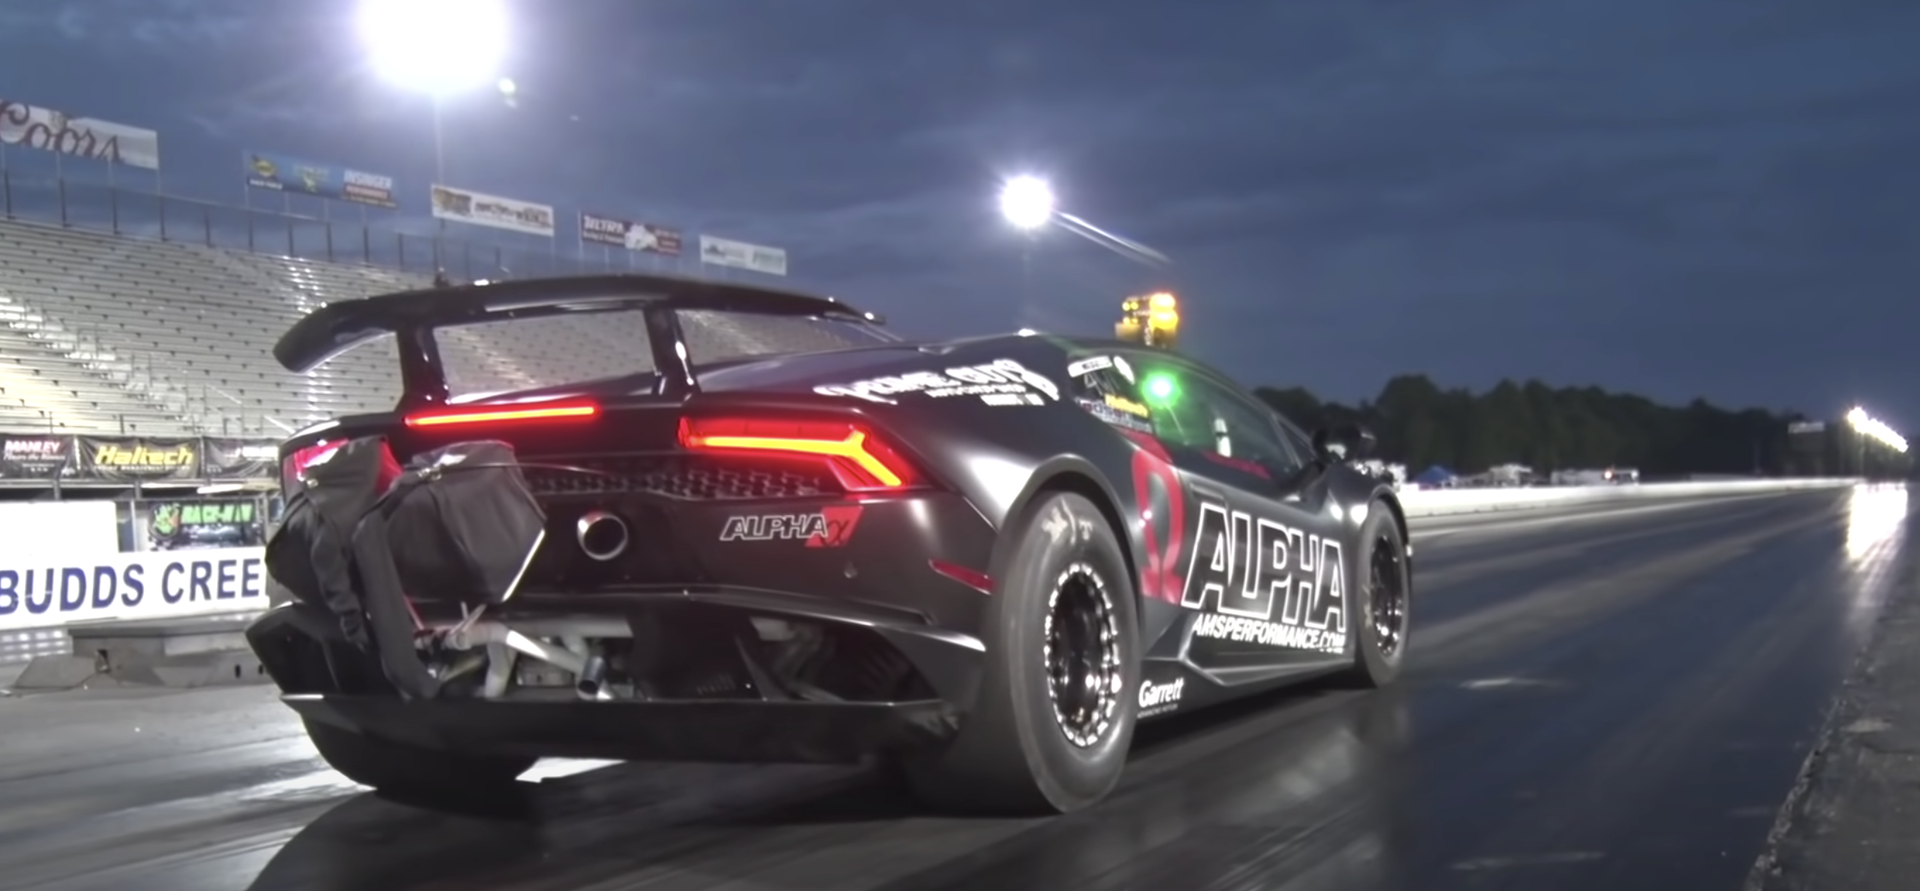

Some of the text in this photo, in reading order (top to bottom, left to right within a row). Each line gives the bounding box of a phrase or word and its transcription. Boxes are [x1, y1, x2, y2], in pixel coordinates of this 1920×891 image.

[0, 101, 124, 163] Coors
[583, 215, 625, 234] ULTRA
[5, 440, 60, 454] MANLEY
[95, 446, 193, 465] Haltech
[719, 513, 828, 541] ALPHA
[1181, 502, 1347, 633] ALPHA
[0, 564, 144, 615] BUDDS
[1192, 614, 1346, 654] AMSPERFORMANCE.COM
[1138, 677, 1185, 708] Garrett
